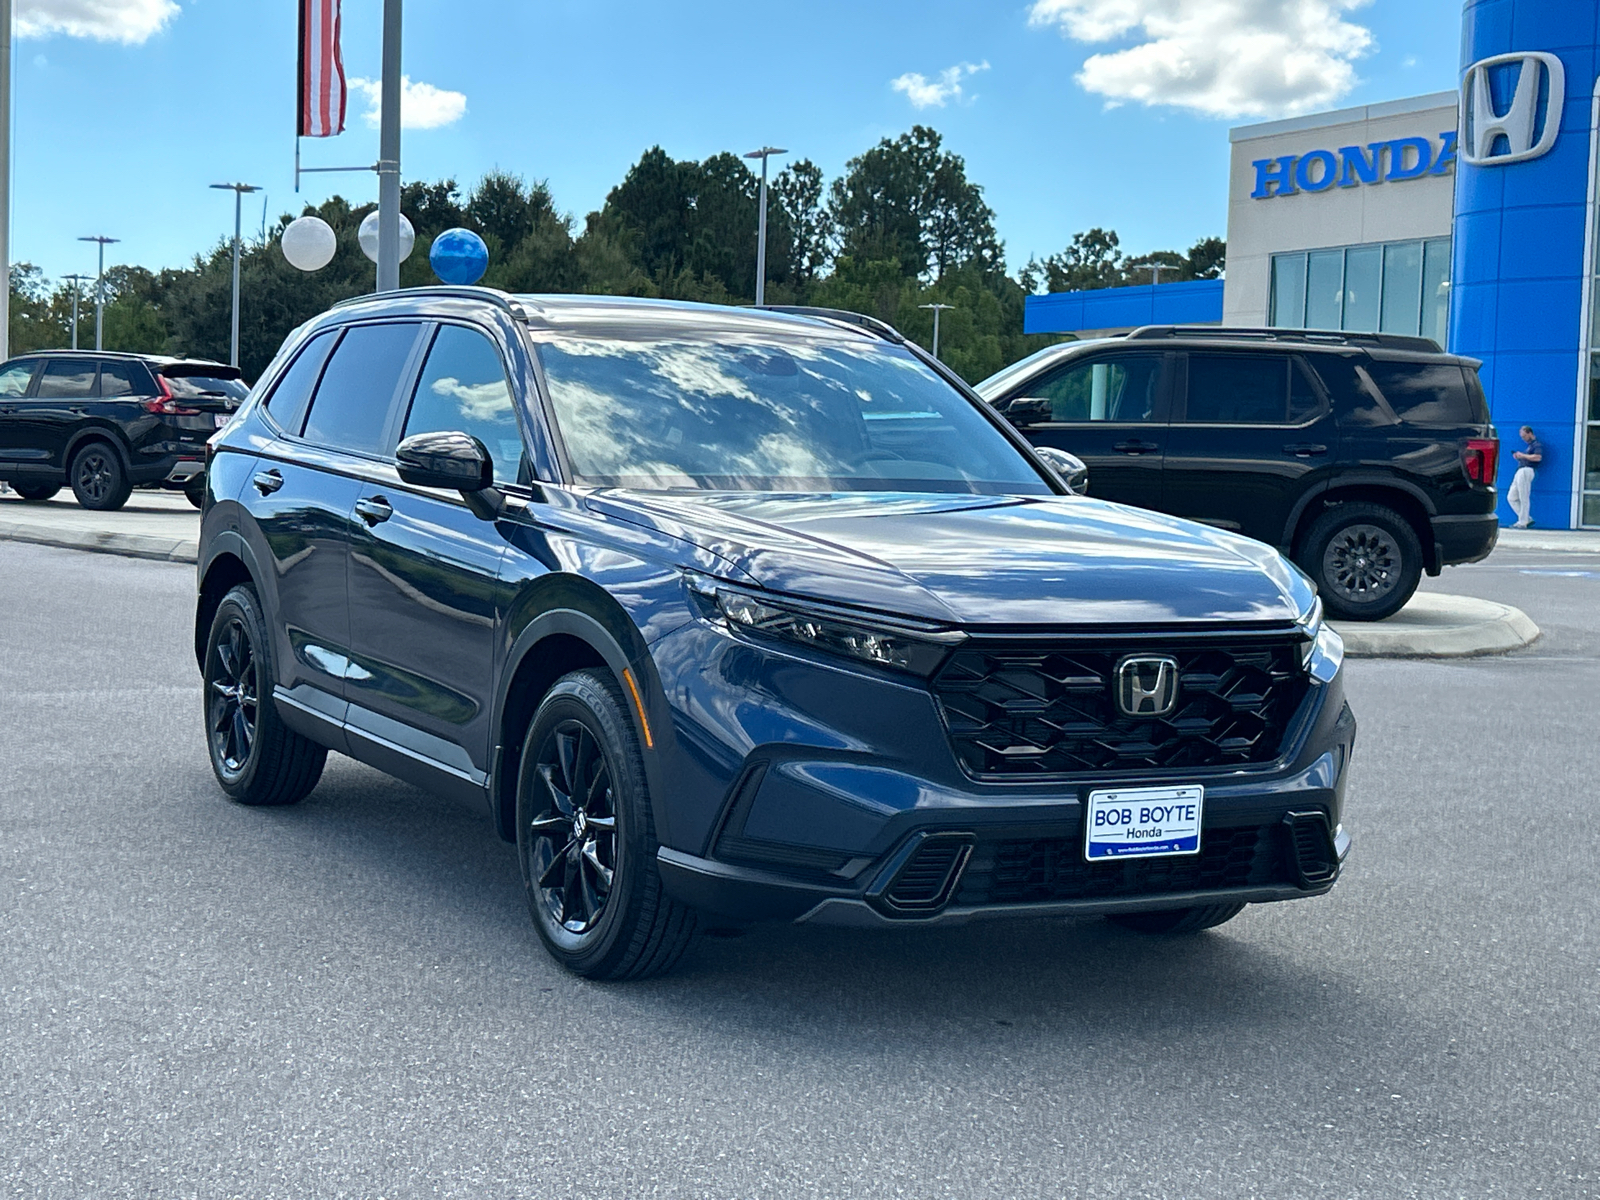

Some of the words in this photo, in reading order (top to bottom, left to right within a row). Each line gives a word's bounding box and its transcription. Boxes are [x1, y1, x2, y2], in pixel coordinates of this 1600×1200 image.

[1095, 808, 1132, 826] BOB
[1140, 805, 1196, 824] BOYTE
[1126, 827, 1162, 839] Honda
